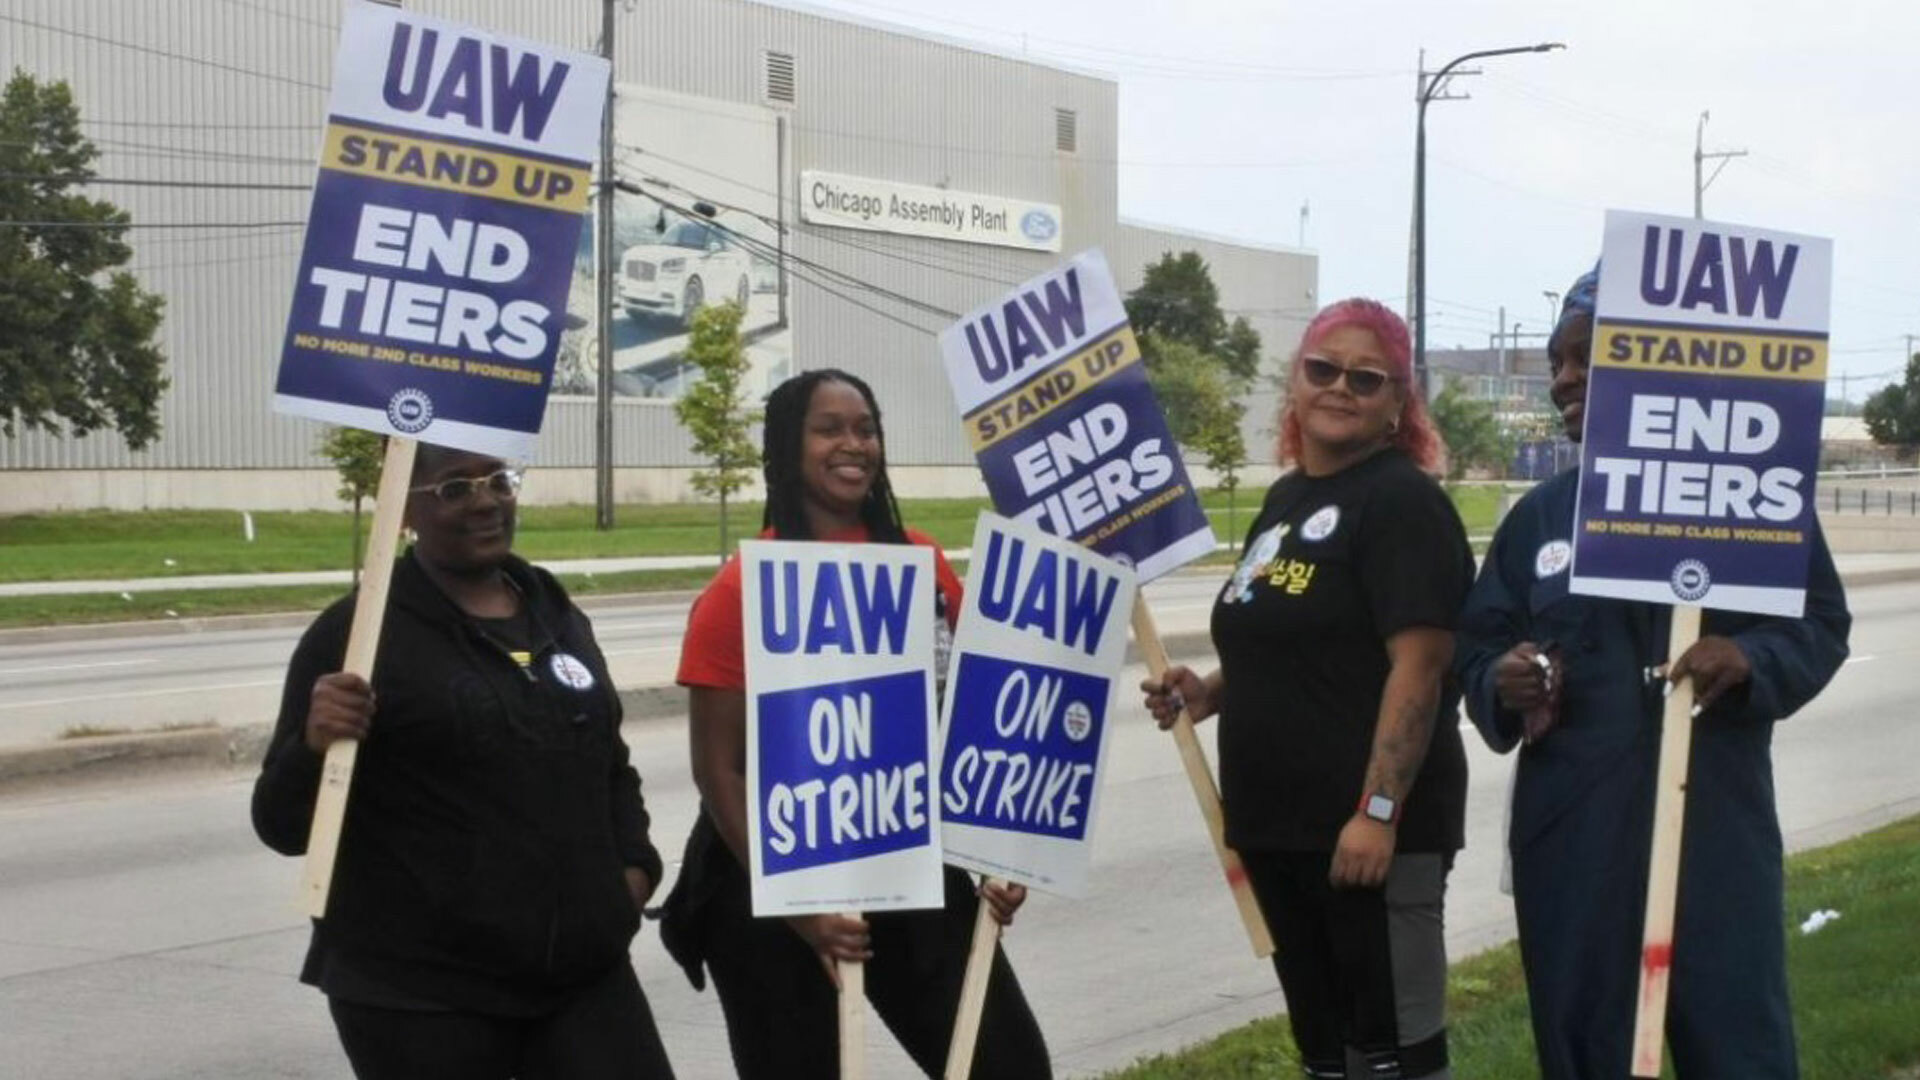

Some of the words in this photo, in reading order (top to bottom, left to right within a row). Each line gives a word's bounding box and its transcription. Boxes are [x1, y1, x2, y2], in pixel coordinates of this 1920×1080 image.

[383, 22, 570, 142] UAW
[338, 135, 498, 188] STAND
[513, 166, 574, 200] UP
[812, 182, 882, 220] Chicago
[889, 194, 964, 230] Assembly
[972, 204, 1007, 231] Plant
[353, 204, 529, 283] END
[1640, 225, 1799, 320] UAW
[310, 267, 551, 359] TIERS
[964, 268, 1086, 384] UAW
[1608, 333, 1746, 369] STAND
[1760, 343, 1814, 372] UP
[294, 334, 319, 349] NO
[323, 339, 370, 357] MORE
[373, 349, 404, 363] 2ND
[409, 354, 461, 372] CLASS
[465, 361, 543, 384] WORKERS
[977, 370, 1075, 442] STAND
[1084, 340, 1124, 377] UP
[1013, 402, 1128, 498] END
[1628, 394, 1781, 455] END
[1098, 513, 1131, 538] CLASS
[1594, 457, 1804, 522] TIERS
[1586, 521, 1607, 533] NO
[1610, 522, 1650, 535] MORE
[1654, 524, 1683, 537] 2ND
[1685, 525, 1731, 539] CLASS
[1734, 528, 1802, 543] WORKERS
[759, 560, 917, 655] UAW
[978, 530, 1120, 656] UAW
[809, 692, 871, 766] ON
[994, 669, 1062, 743] ON
[767, 761, 926, 855] STRIKE
[943, 746, 1092, 828] STRIKE
